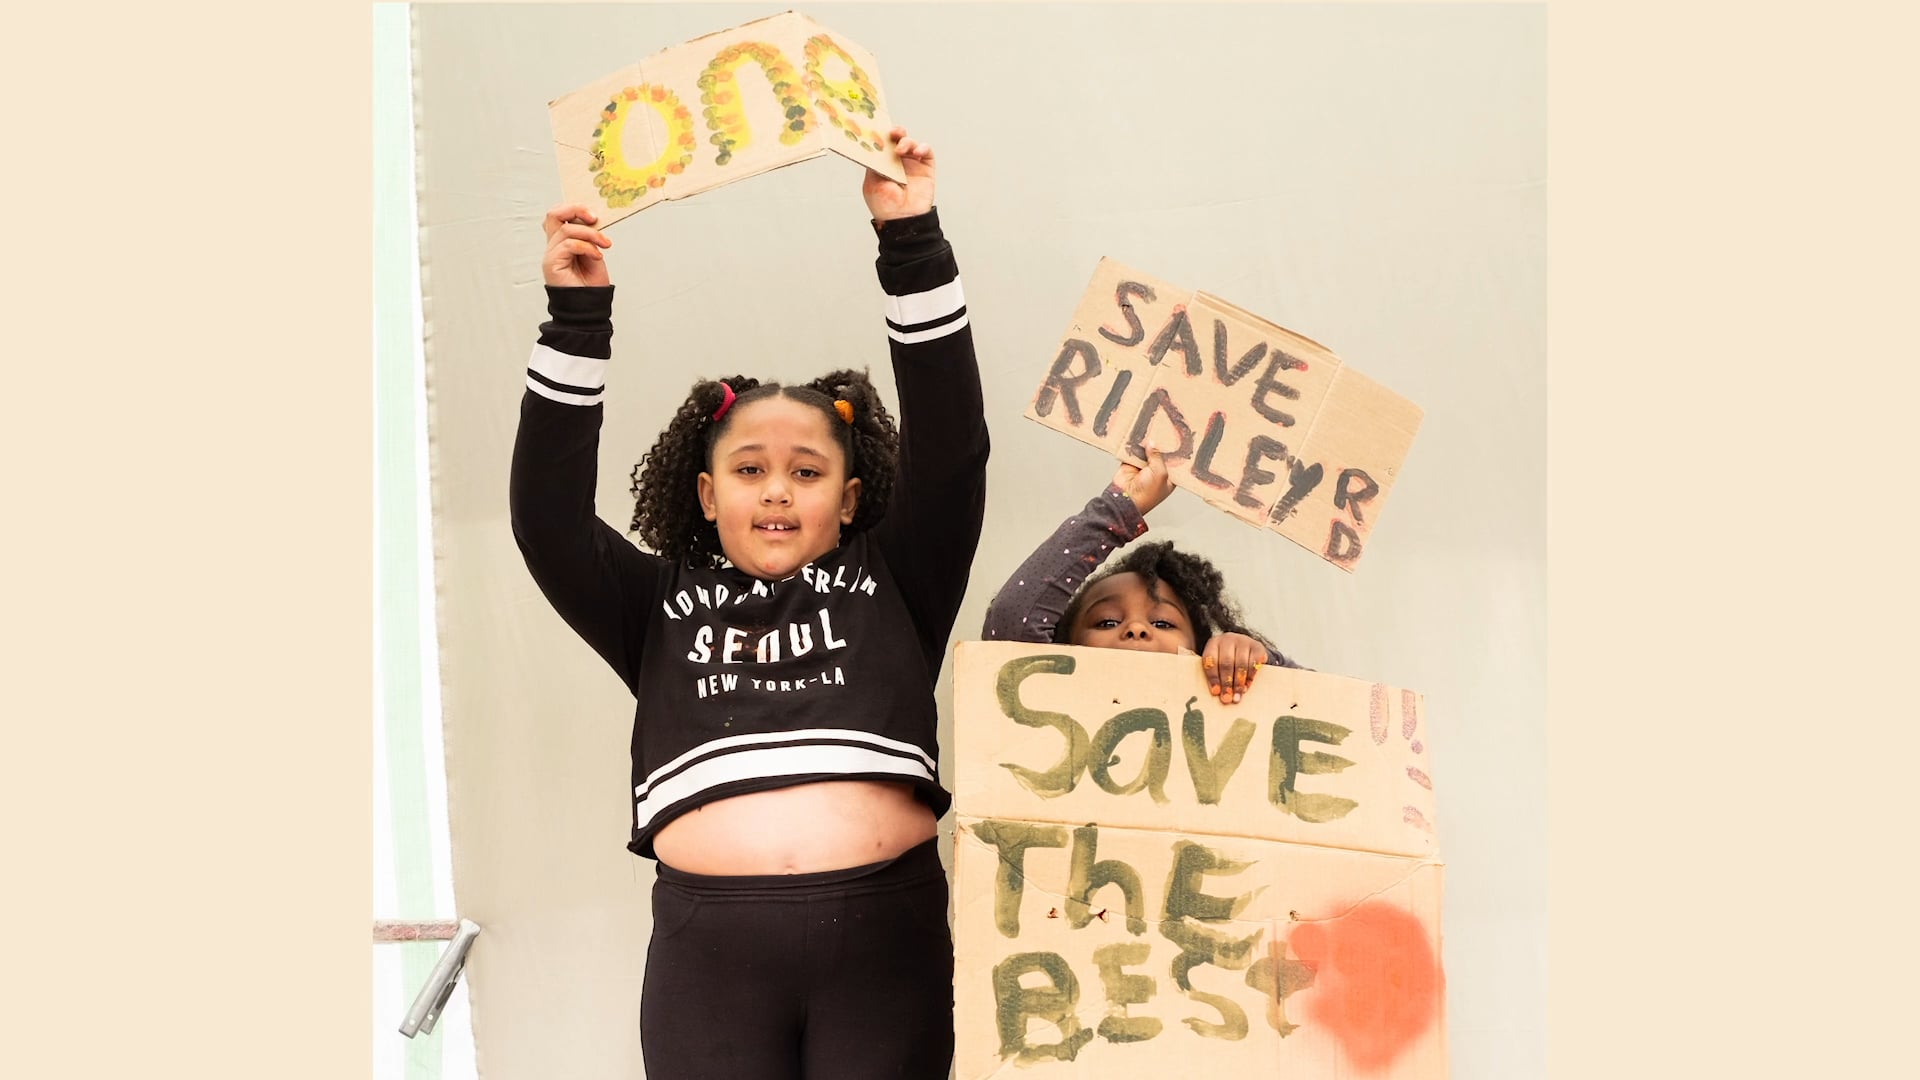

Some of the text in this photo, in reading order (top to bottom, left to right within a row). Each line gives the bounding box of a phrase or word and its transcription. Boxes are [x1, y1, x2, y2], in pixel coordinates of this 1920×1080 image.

[588, 33, 884, 209] one
[1098, 280, 1309, 428] SAVE
[1034, 338, 1324, 525] RIDLEY
[687, 608, 847, 664] SEOUL
[697, 674, 739, 699] NEW
